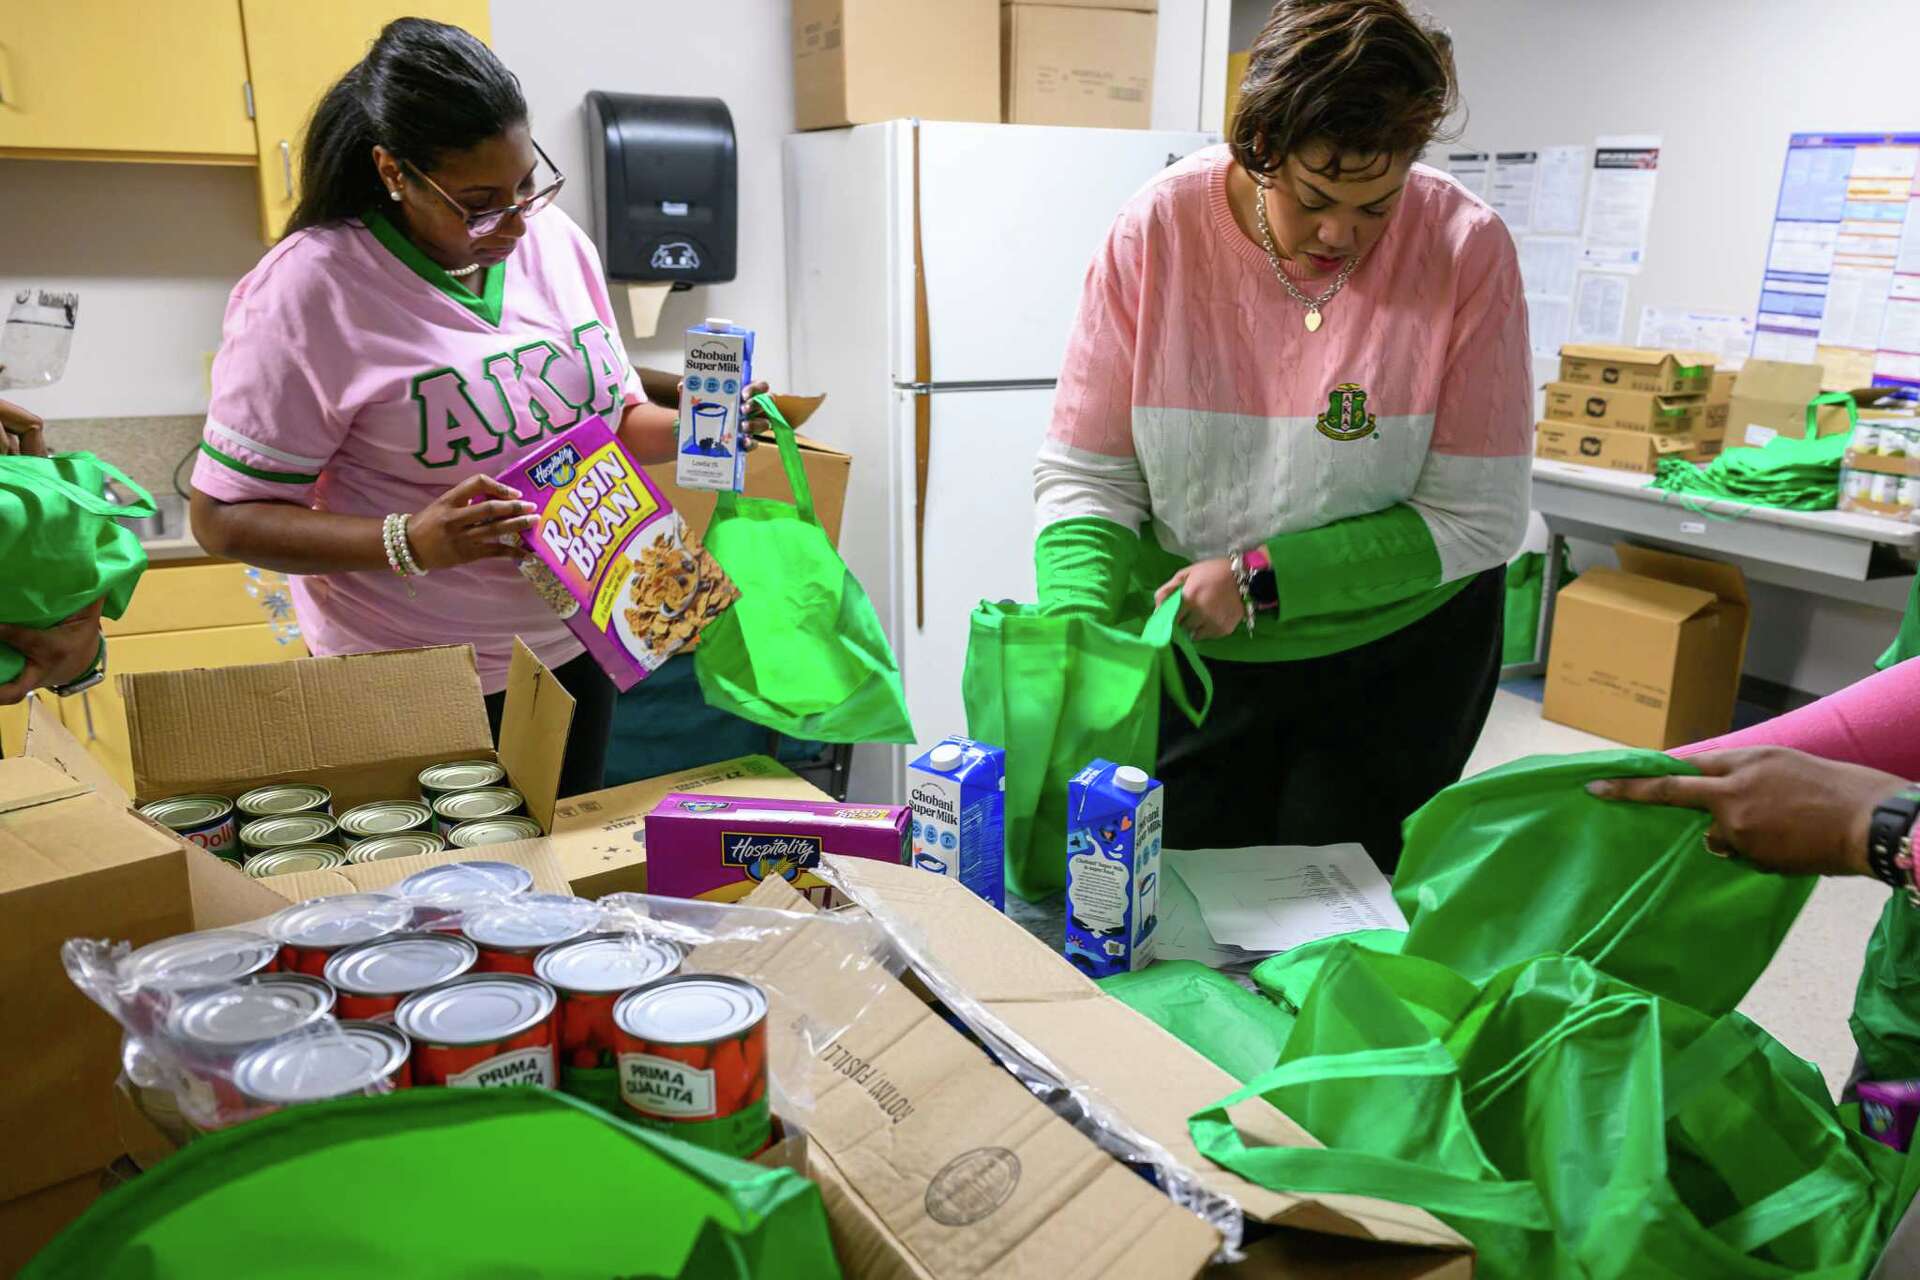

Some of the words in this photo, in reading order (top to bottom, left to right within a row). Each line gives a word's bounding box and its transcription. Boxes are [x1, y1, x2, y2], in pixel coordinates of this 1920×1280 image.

[686, 359, 717, 371] Super
[717, 362, 740, 373] Milk
[691, 349, 737, 362] Chobani
[411, 320, 630, 469] AKA
[534, 446, 575, 484] Hospitality
[541, 451, 628, 566] RAISIN
[567, 483, 640, 581] BRAN
[909, 799, 936, 818] Super
[936, 809, 958, 826] Milk
[911, 788, 954, 813] Chobani
[730, 837, 816, 865] Hospitality
[478, 1058, 537, 1088] PRIMA
[630, 1064, 684, 1086] PRIMA
